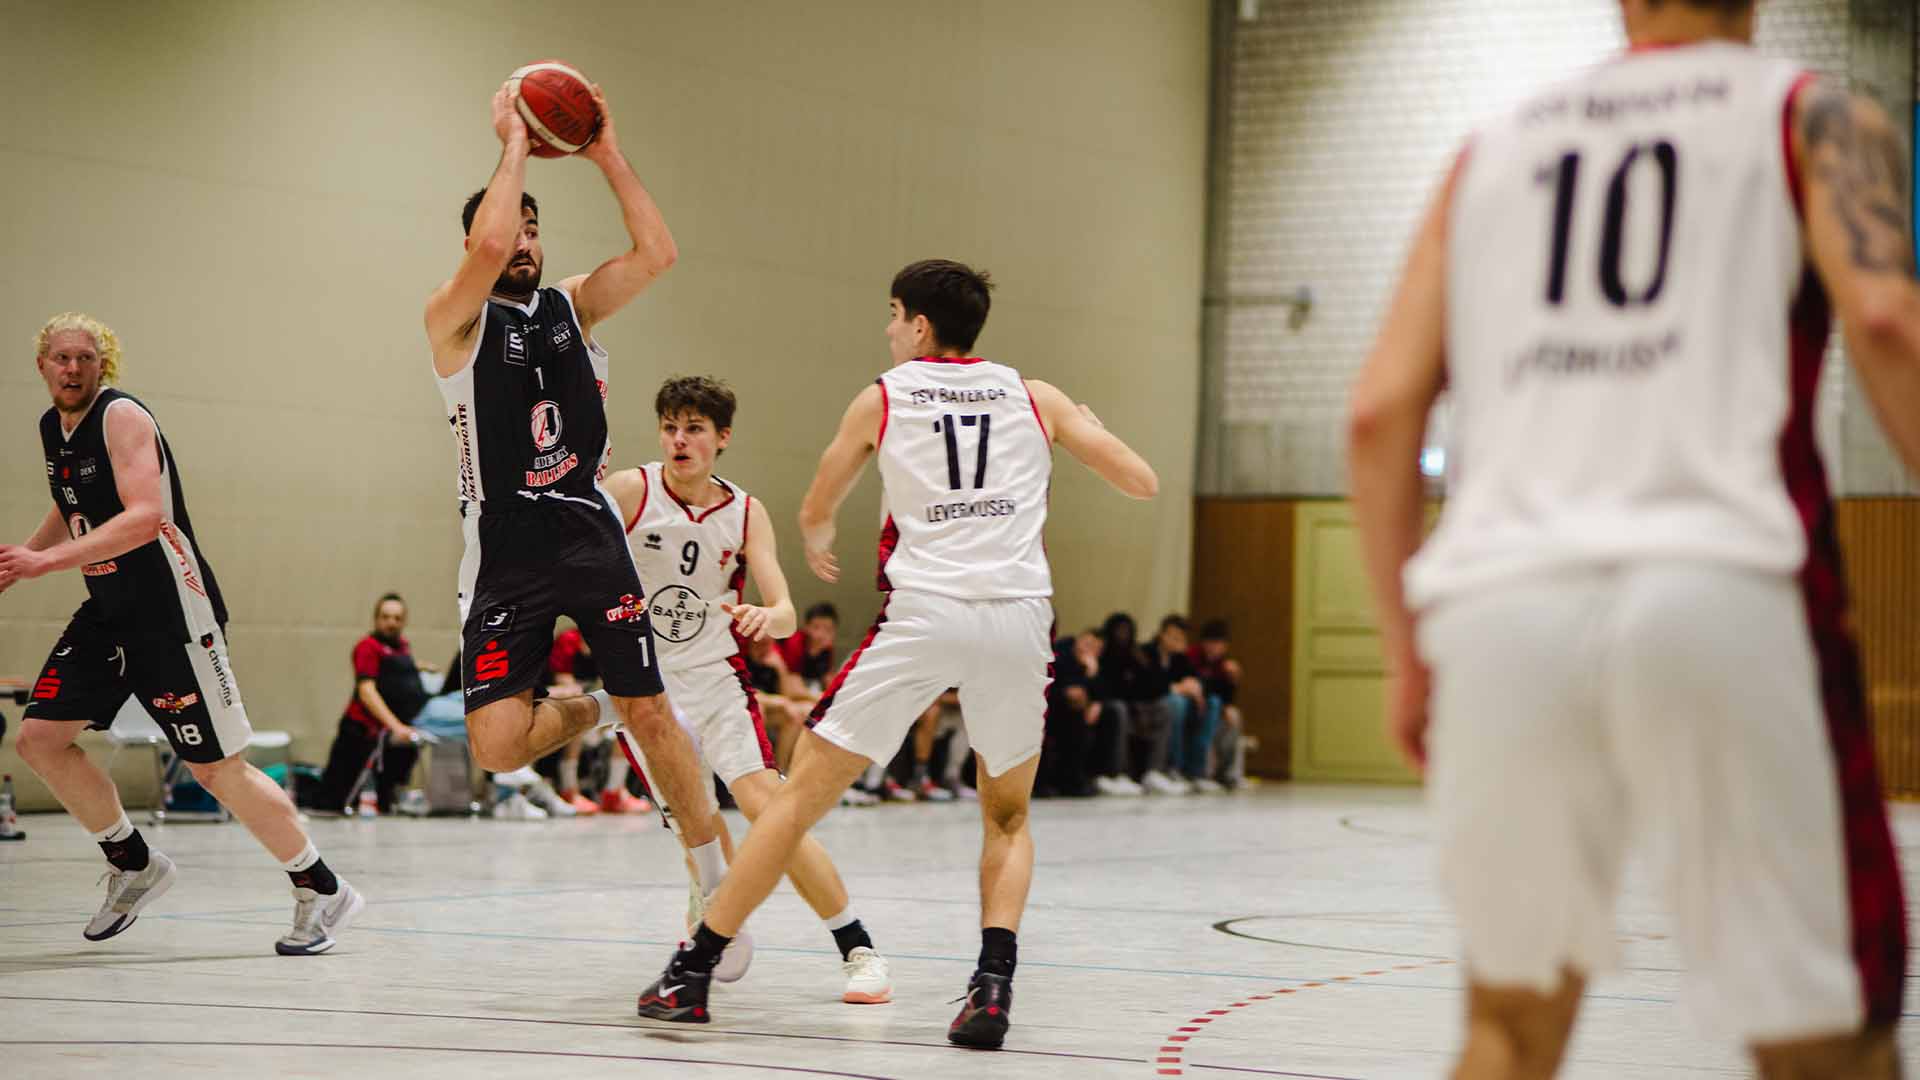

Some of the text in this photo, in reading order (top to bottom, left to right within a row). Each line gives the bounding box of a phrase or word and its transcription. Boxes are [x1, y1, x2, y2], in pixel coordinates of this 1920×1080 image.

[1534, 140, 1678, 306] 10
[535, 367, 544, 389] 1
[911, 388, 936, 405] TSV
[933, 414, 990, 490] 17
[526, 453, 578, 486] BALLERS
[62, 487, 78, 504] 18
[680, 540, 699, 576] 9
[653, 605, 702, 621] BAYE
[670, 591, 688, 639] BAYER
[638, 636, 649, 667] 1
[208, 649, 232, 706] charisma
[171, 723, 203, 745] 18
